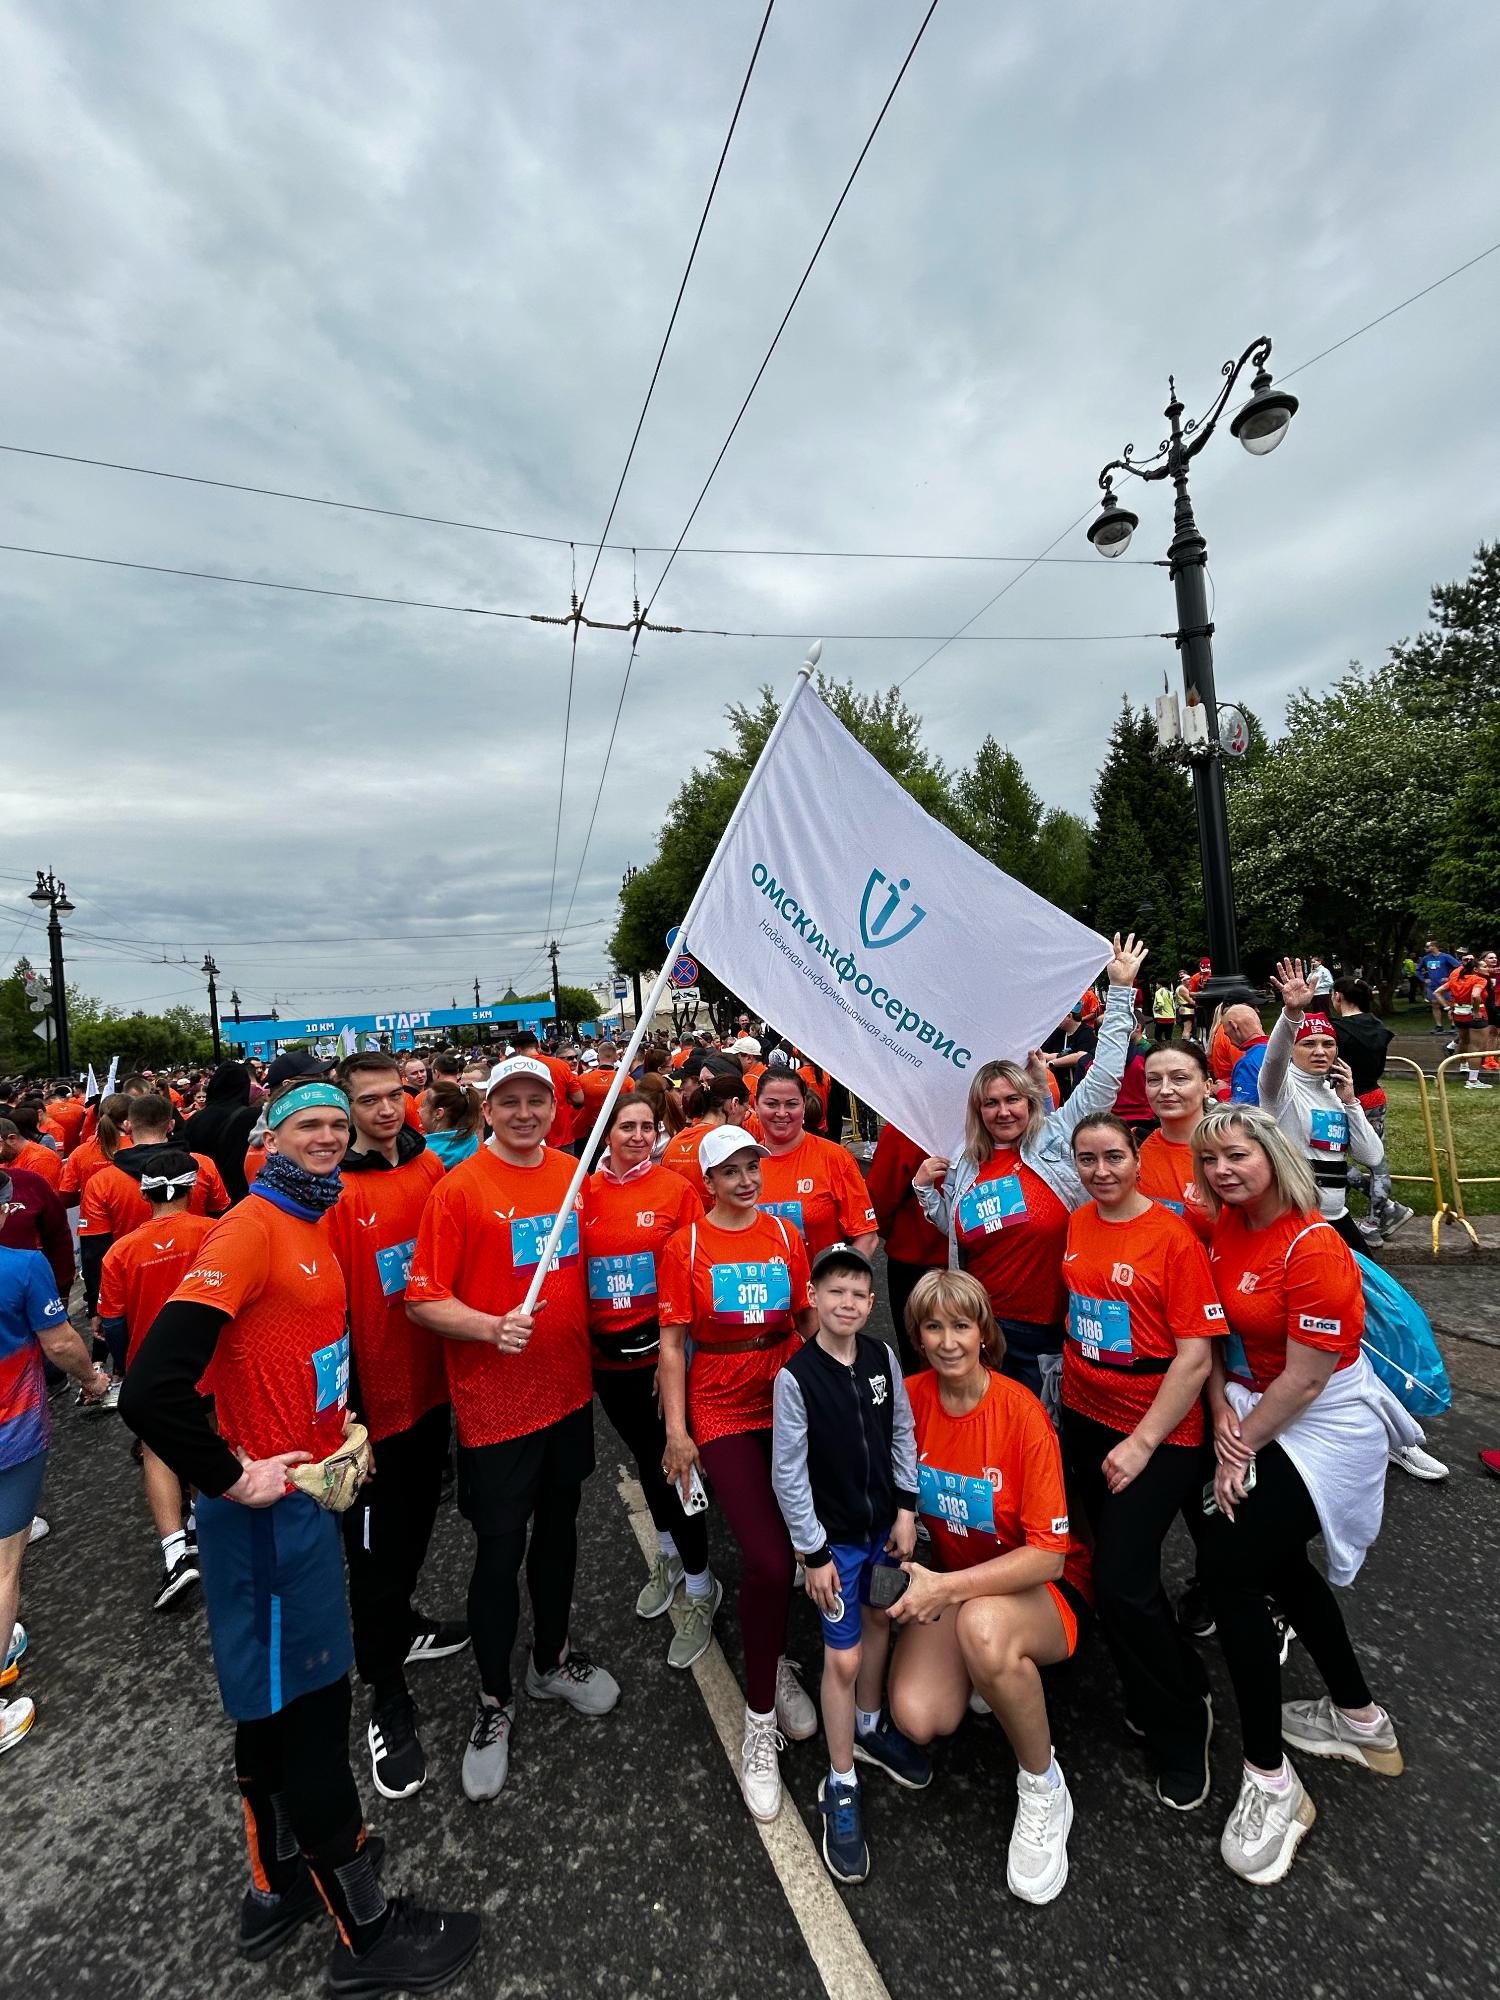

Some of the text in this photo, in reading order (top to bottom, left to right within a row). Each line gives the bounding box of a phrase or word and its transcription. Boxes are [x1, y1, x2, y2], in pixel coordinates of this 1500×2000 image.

[759, 918, 924, 1069] Надёжная информационная защита
[375, 1012, 431, 1031] СТАРТ
[472, 1012, 478, 1020] 5
[305, 1024, 318, 1033] 10
[797, 1178, 814, 1193] 10
[975, 1195, 1001, 1219] 3187
[636, 1210, 656, 1227] 10
[745, 1265, 758, 1277] 10
[1111, 1262, 1135, 1287] 10
[606, 1273, 635, 1293] 3184
[1236, 1271, 1261, 1295] 10
[737, 1283, 768, 1305] 3175
[1076, 1315, 1104, 1342] 3186
[944, 1475, 956, 1489] 10
[937, 1493, 969, 1521] 3183
